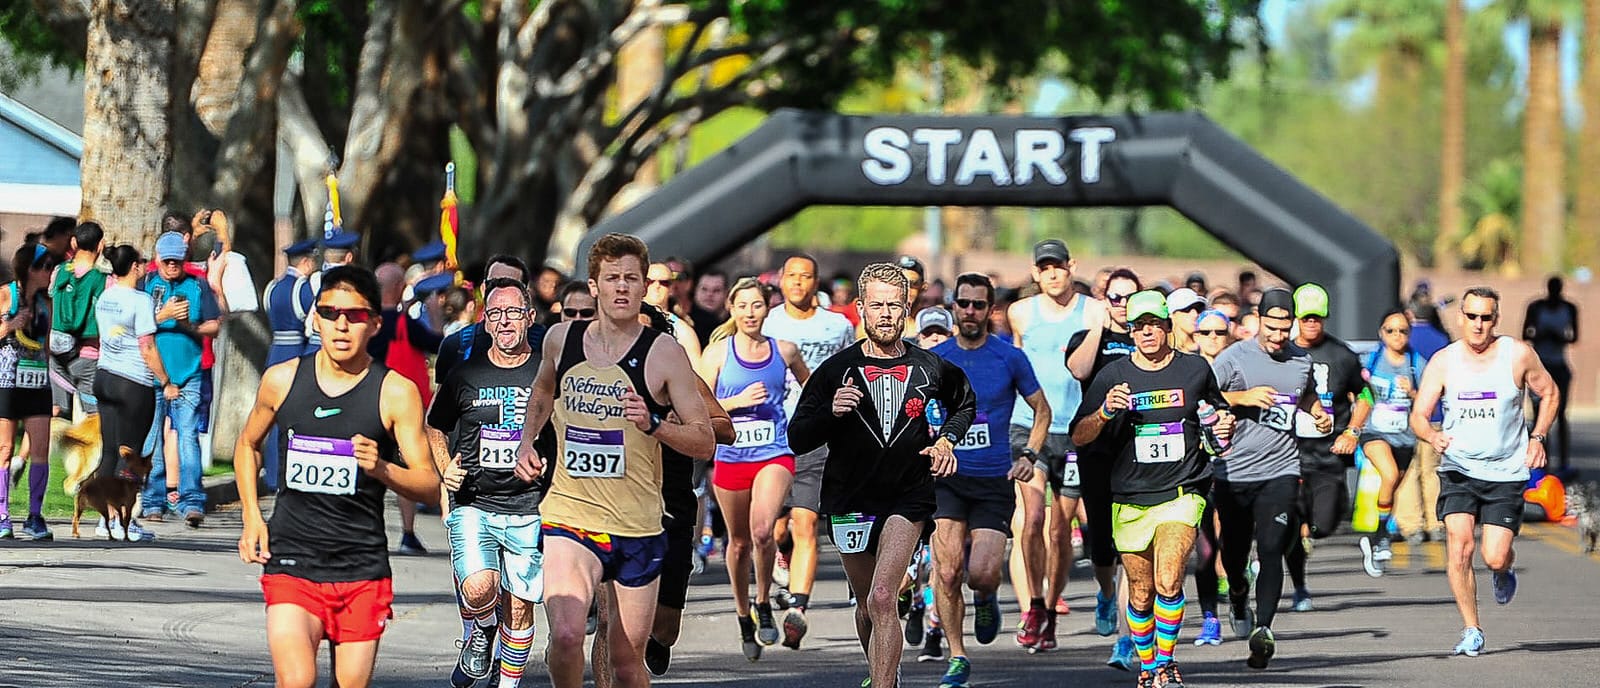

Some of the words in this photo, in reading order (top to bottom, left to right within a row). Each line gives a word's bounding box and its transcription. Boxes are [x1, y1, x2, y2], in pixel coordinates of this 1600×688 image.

[861, 127, 1116, 186] START
[479, 386, 516, 400] PRIDE
[503, 397, 516, 425] RUN
[1460, 407, 1495, 419] 2044
[736, 427, 771, 443] 2167
[1149, 443, 1169, 459] 31
[566, 450, 620, 474] 2397
[290, 463, 350, 488] 2023
[846, 530, 864, 549] 37
